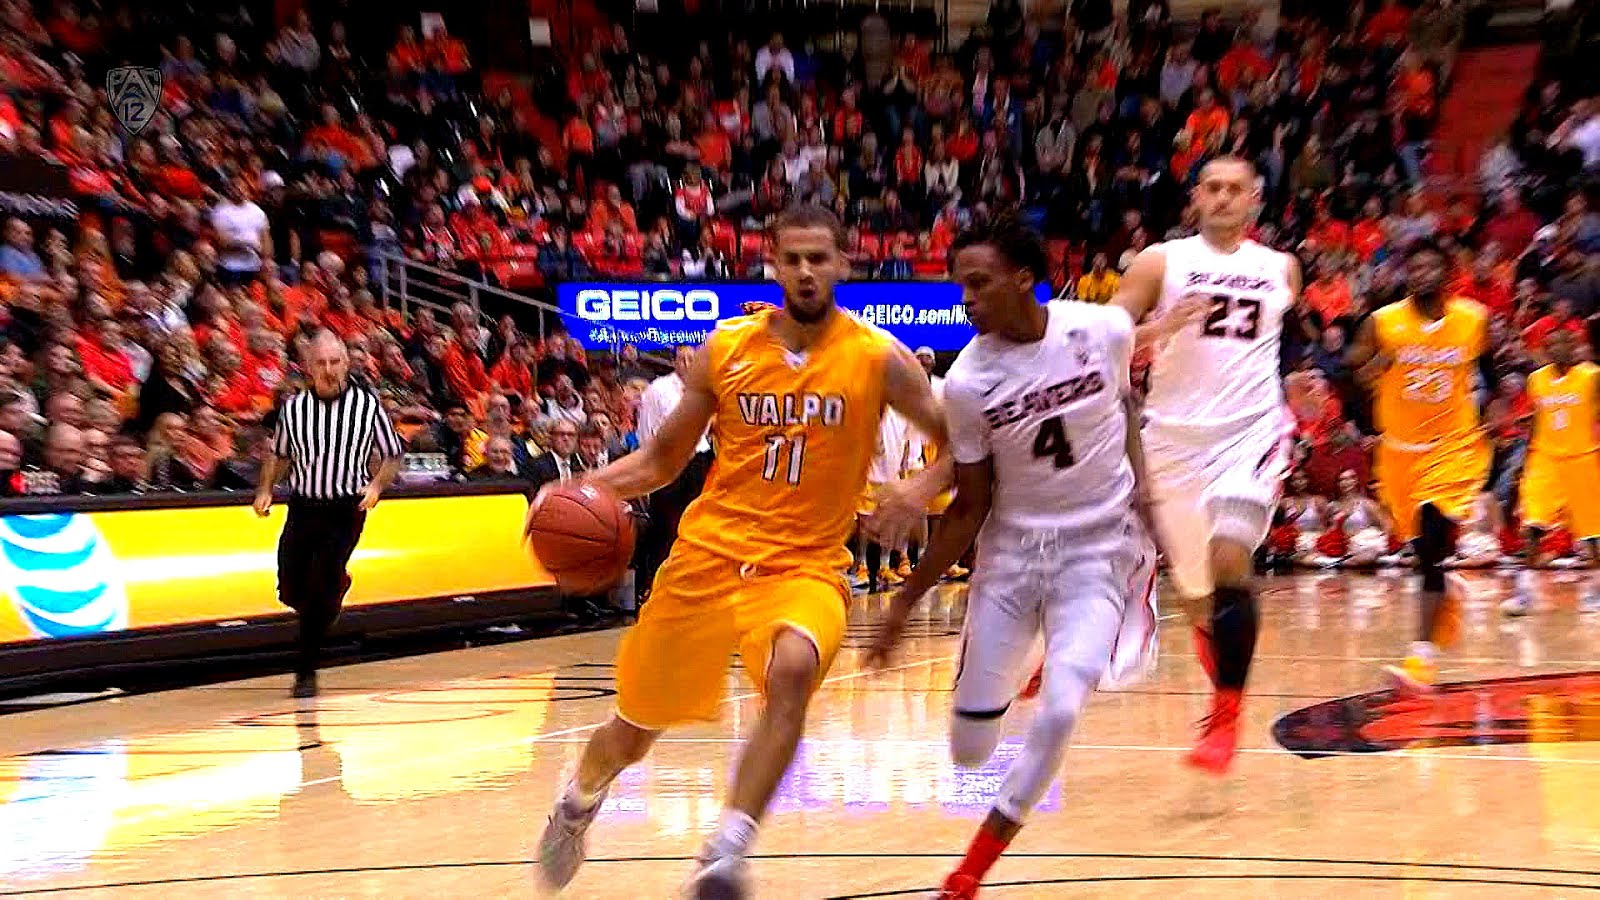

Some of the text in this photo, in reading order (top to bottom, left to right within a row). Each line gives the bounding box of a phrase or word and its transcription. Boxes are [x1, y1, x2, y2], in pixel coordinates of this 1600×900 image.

[576, 289, 720, 321] GEICO
[1201, 295, 1261, 340] 23
[736, 392, 846, 427] VALPO
[761, 433, 807, 486] 11
[1033, 415, 1075, 471] 4
